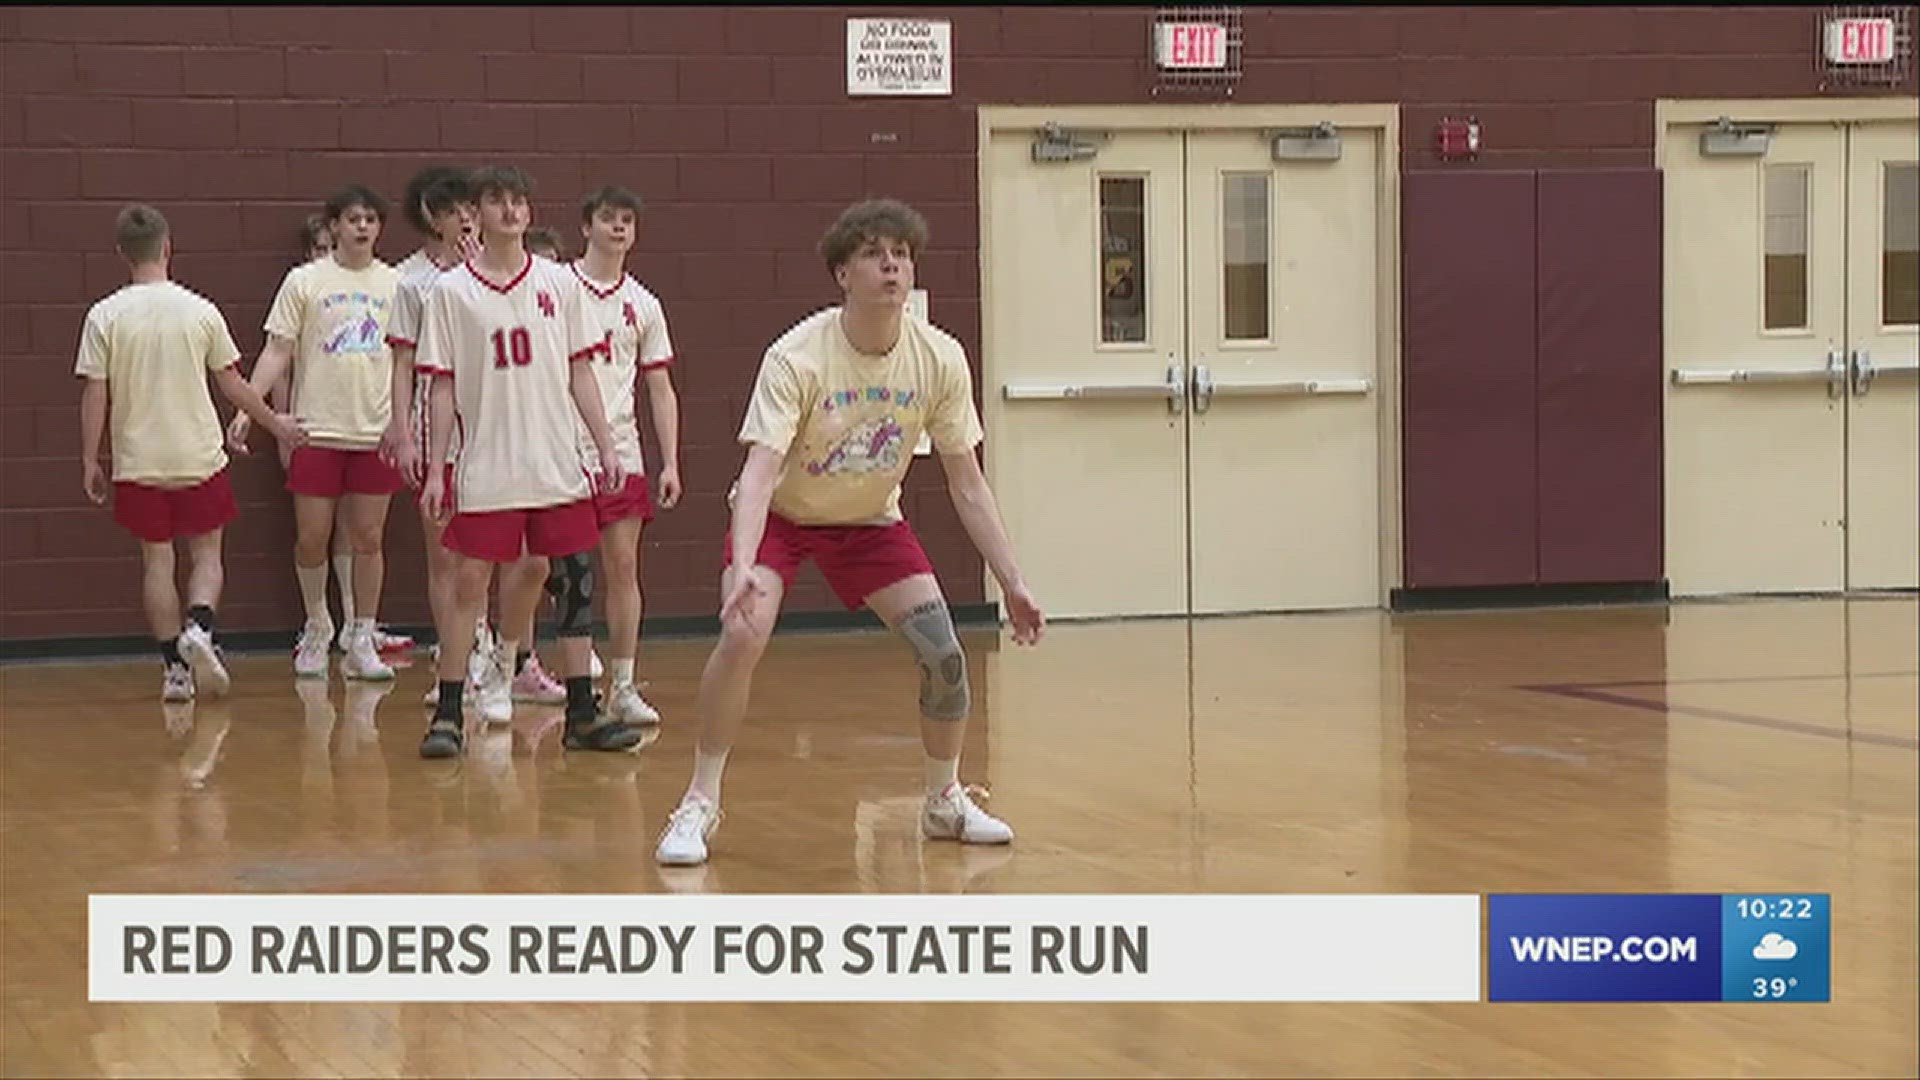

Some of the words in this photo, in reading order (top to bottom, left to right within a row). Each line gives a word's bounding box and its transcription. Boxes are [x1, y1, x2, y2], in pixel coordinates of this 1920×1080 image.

[866, 22, 888, 37] NO
[892, 22, 931, 37] FOOD
[1173, 27, 1219, 63] EXIT
[1843, 22, 1887, 60] EXIT
[491, 327, 532, 369] 10
